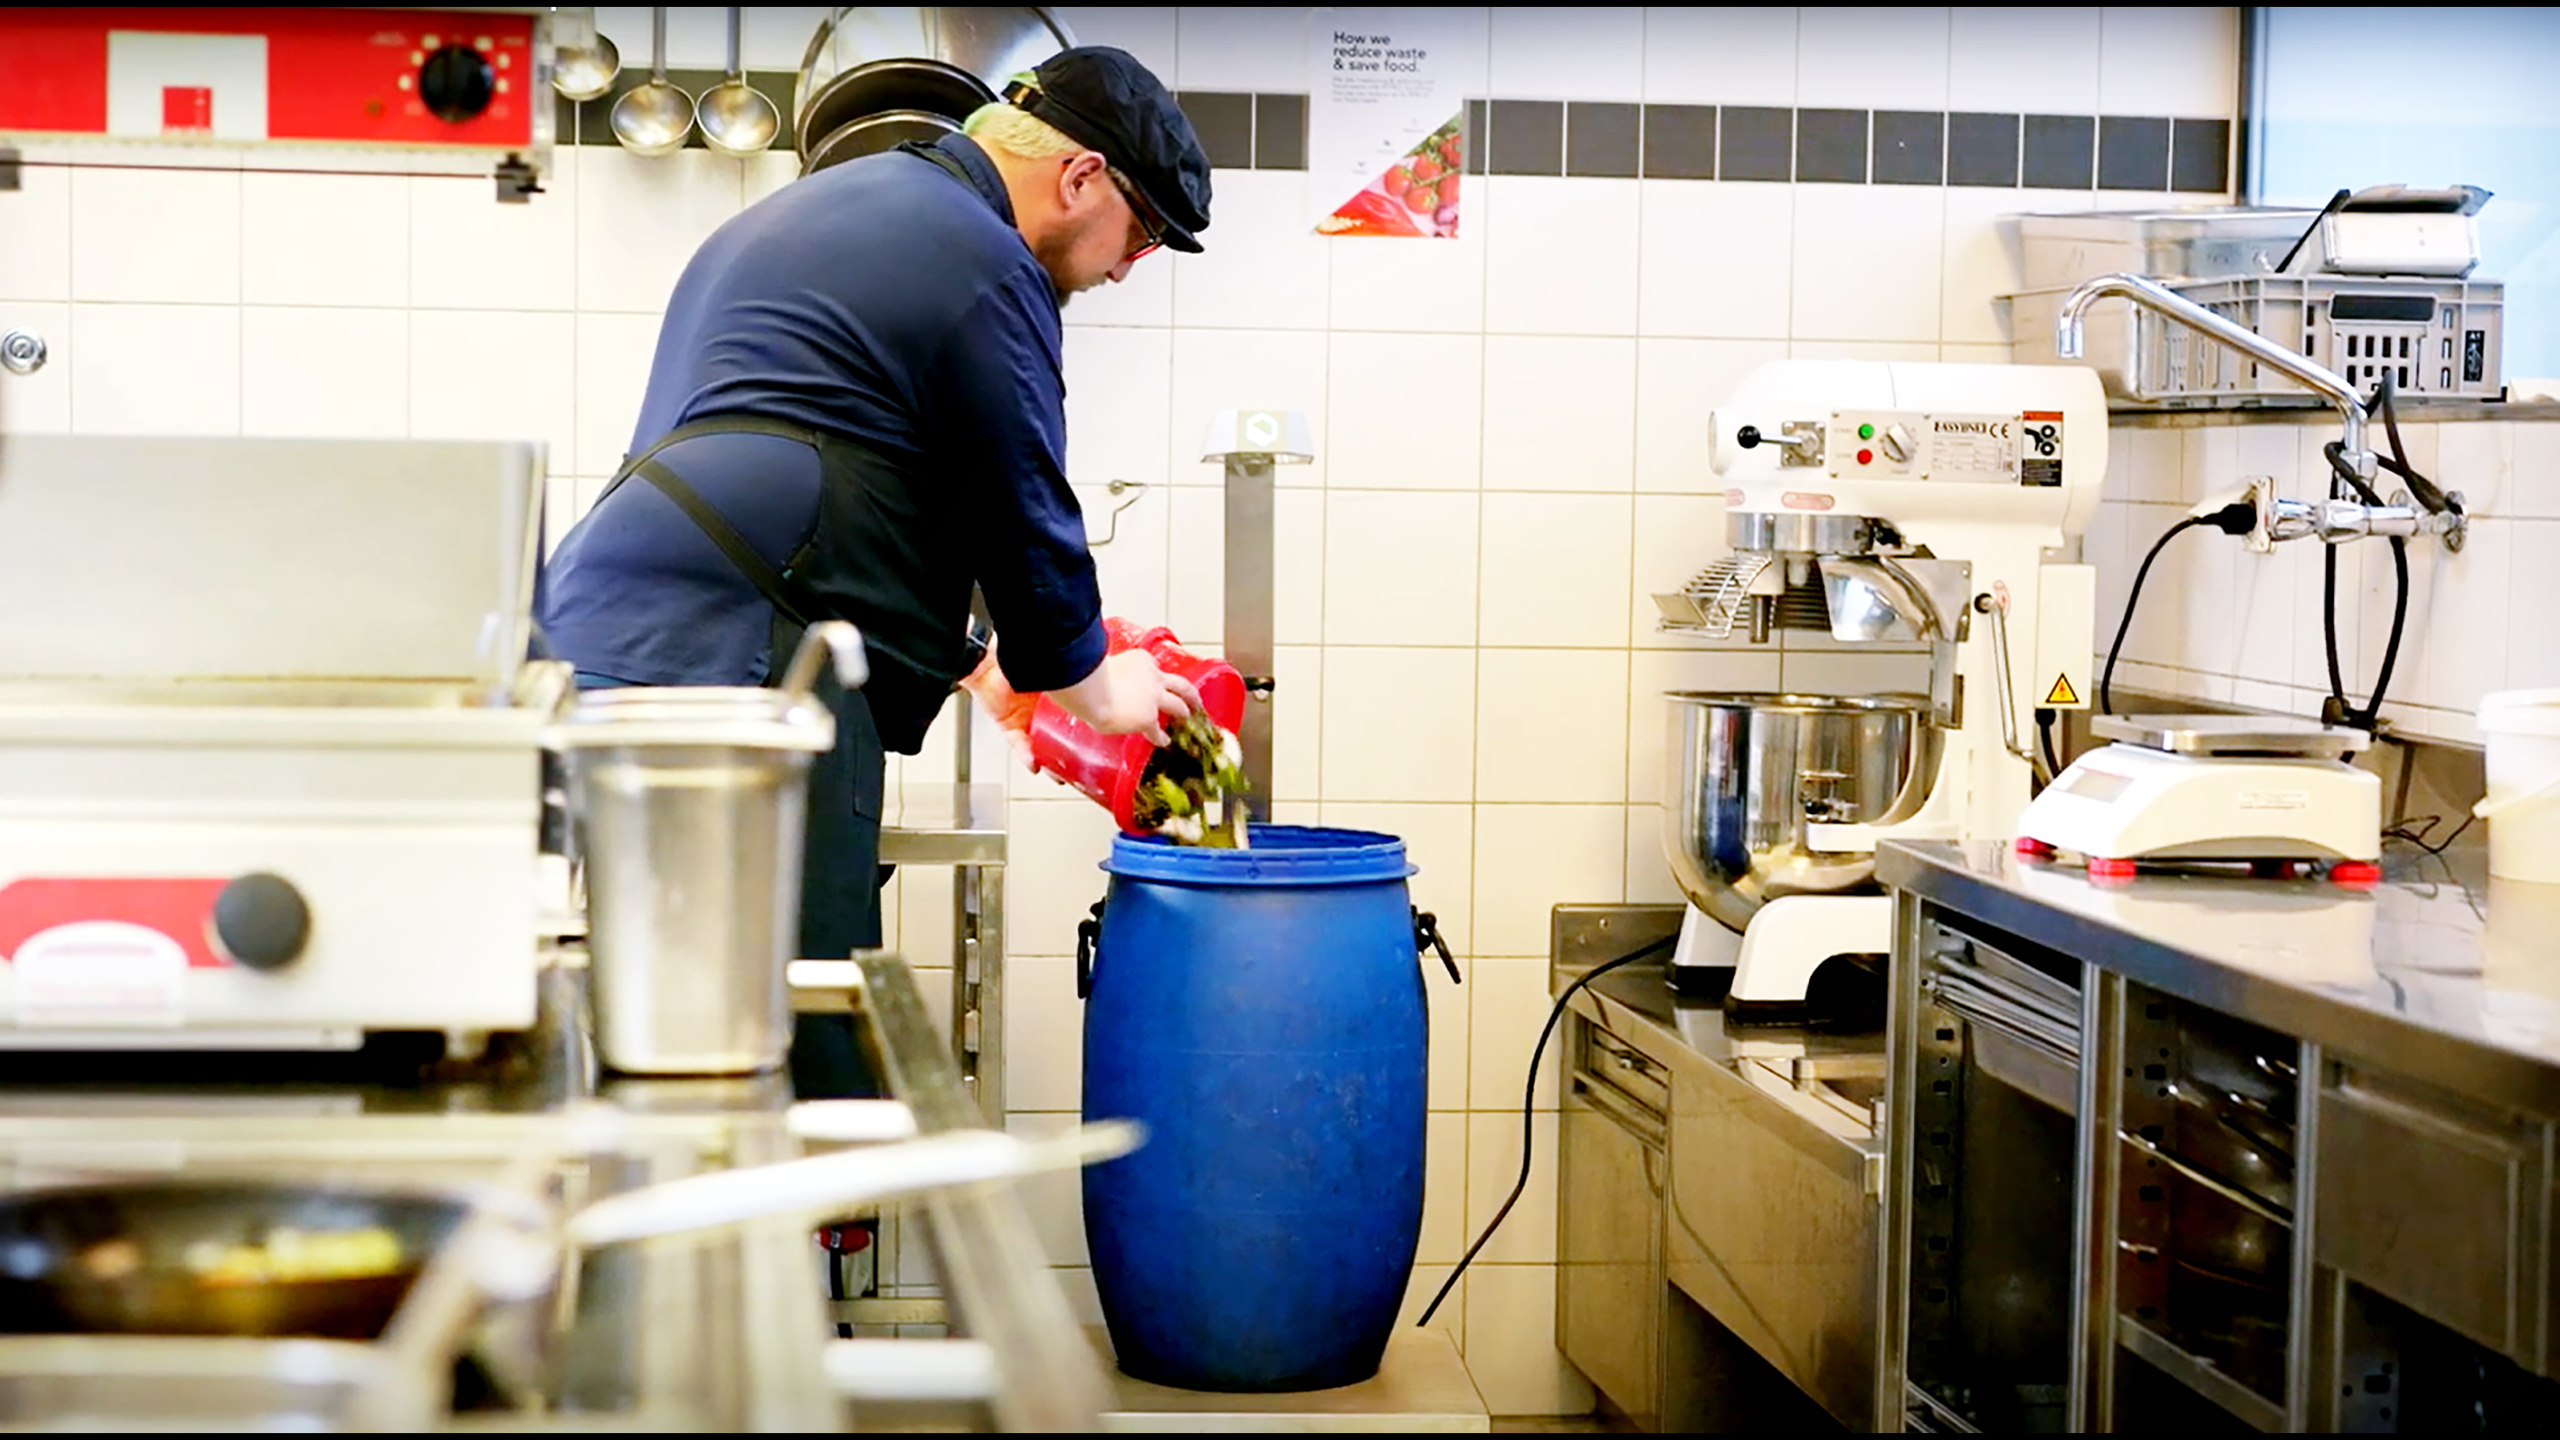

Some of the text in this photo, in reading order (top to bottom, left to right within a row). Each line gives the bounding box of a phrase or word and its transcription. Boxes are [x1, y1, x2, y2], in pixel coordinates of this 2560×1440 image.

[1333, 31, 1391, 45] How we
[1333, 45, 1427, 59] reduce waste
[1333, 58, 1421, 72] & save food.
